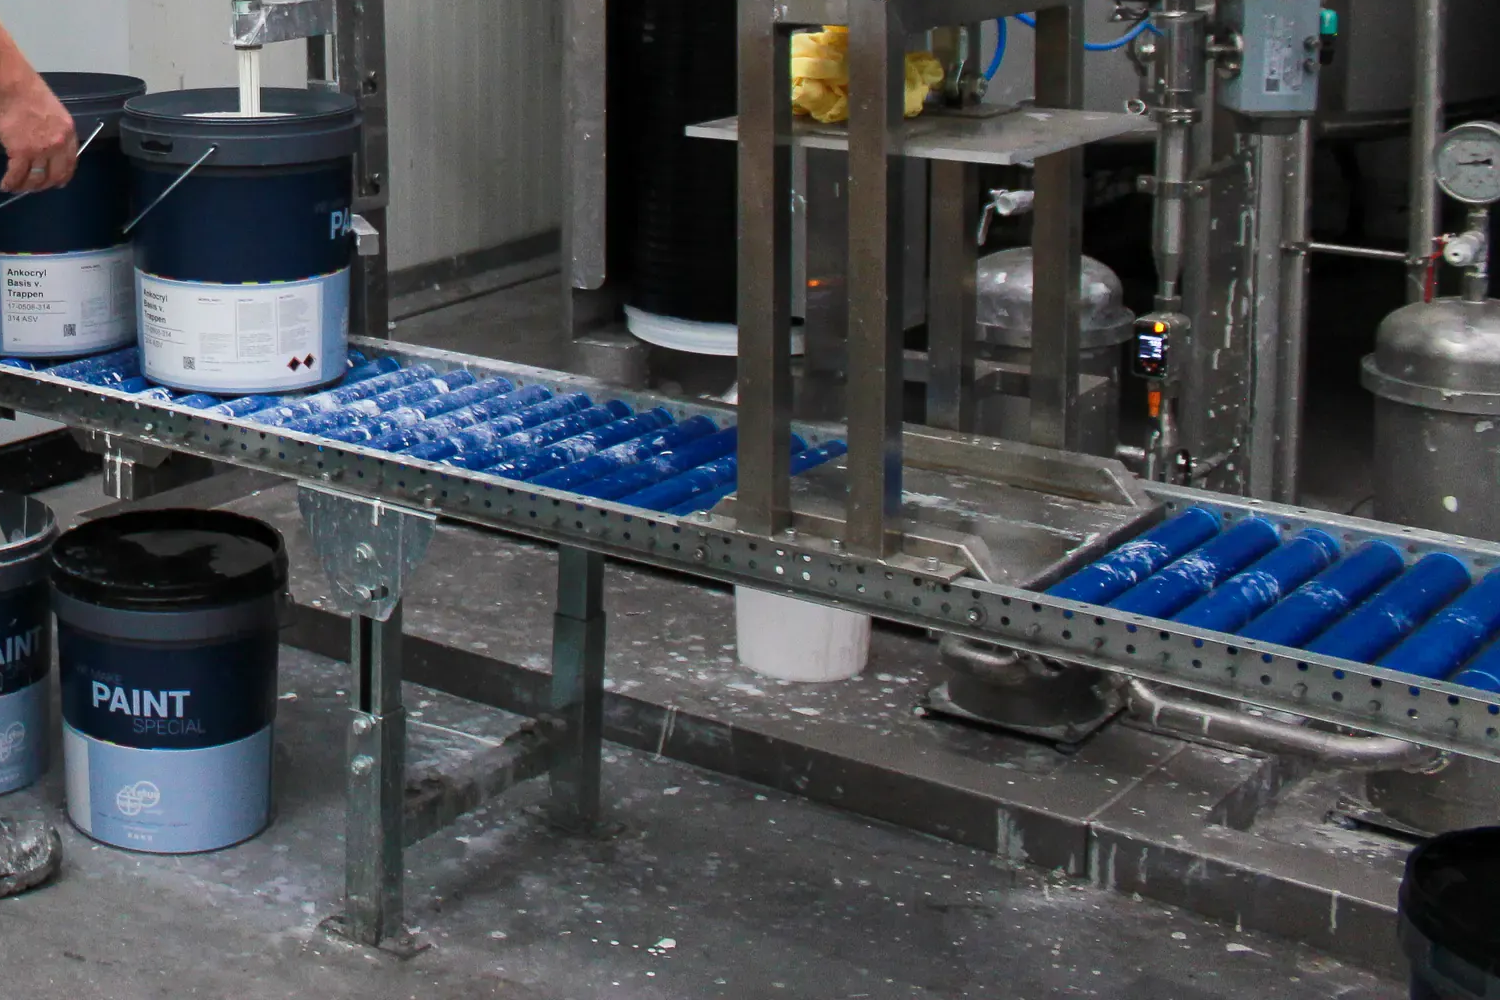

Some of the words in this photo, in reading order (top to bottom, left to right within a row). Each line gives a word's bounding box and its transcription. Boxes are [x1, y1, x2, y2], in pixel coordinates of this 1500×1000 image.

[7, 268, 47, 279] Ankocryl
[7, 278, 32, 288] Basis
[7, 289, 44, 299] Trappen
[22, 315, 39, 323] ASV
[92, 680, 191, 718] PAINT
[133, 718, 207, 736] SPECIAL
